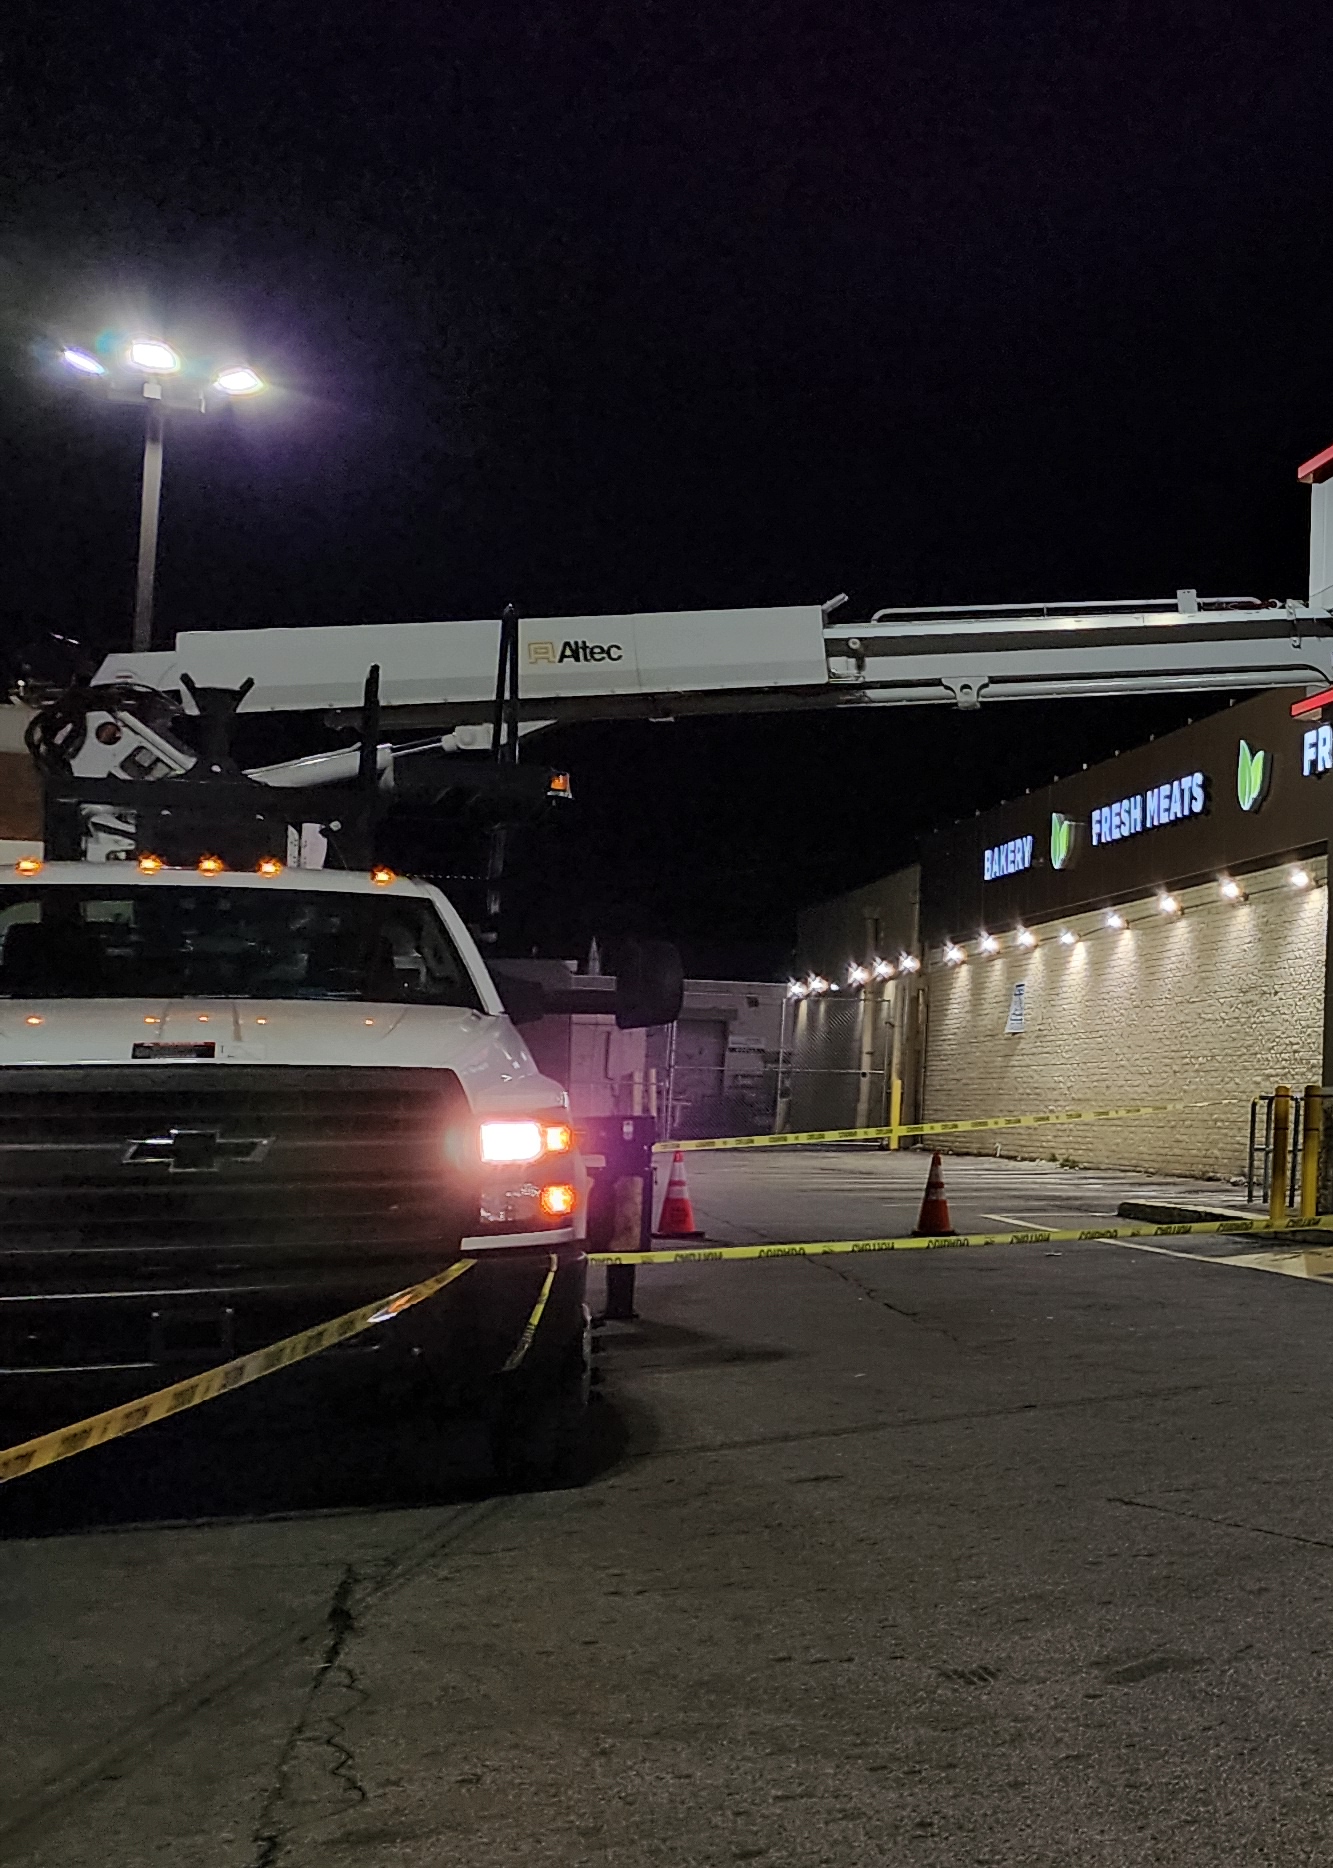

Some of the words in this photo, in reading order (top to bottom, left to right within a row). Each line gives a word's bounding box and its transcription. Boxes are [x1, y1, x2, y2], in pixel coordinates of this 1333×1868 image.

[557, 640, 623, 663] Altec
[1091, 794, 1143, 846] FRESH
[1145, 772, 1205, 829] MEATS
[984, 835, 1033, 881] BAKERY
